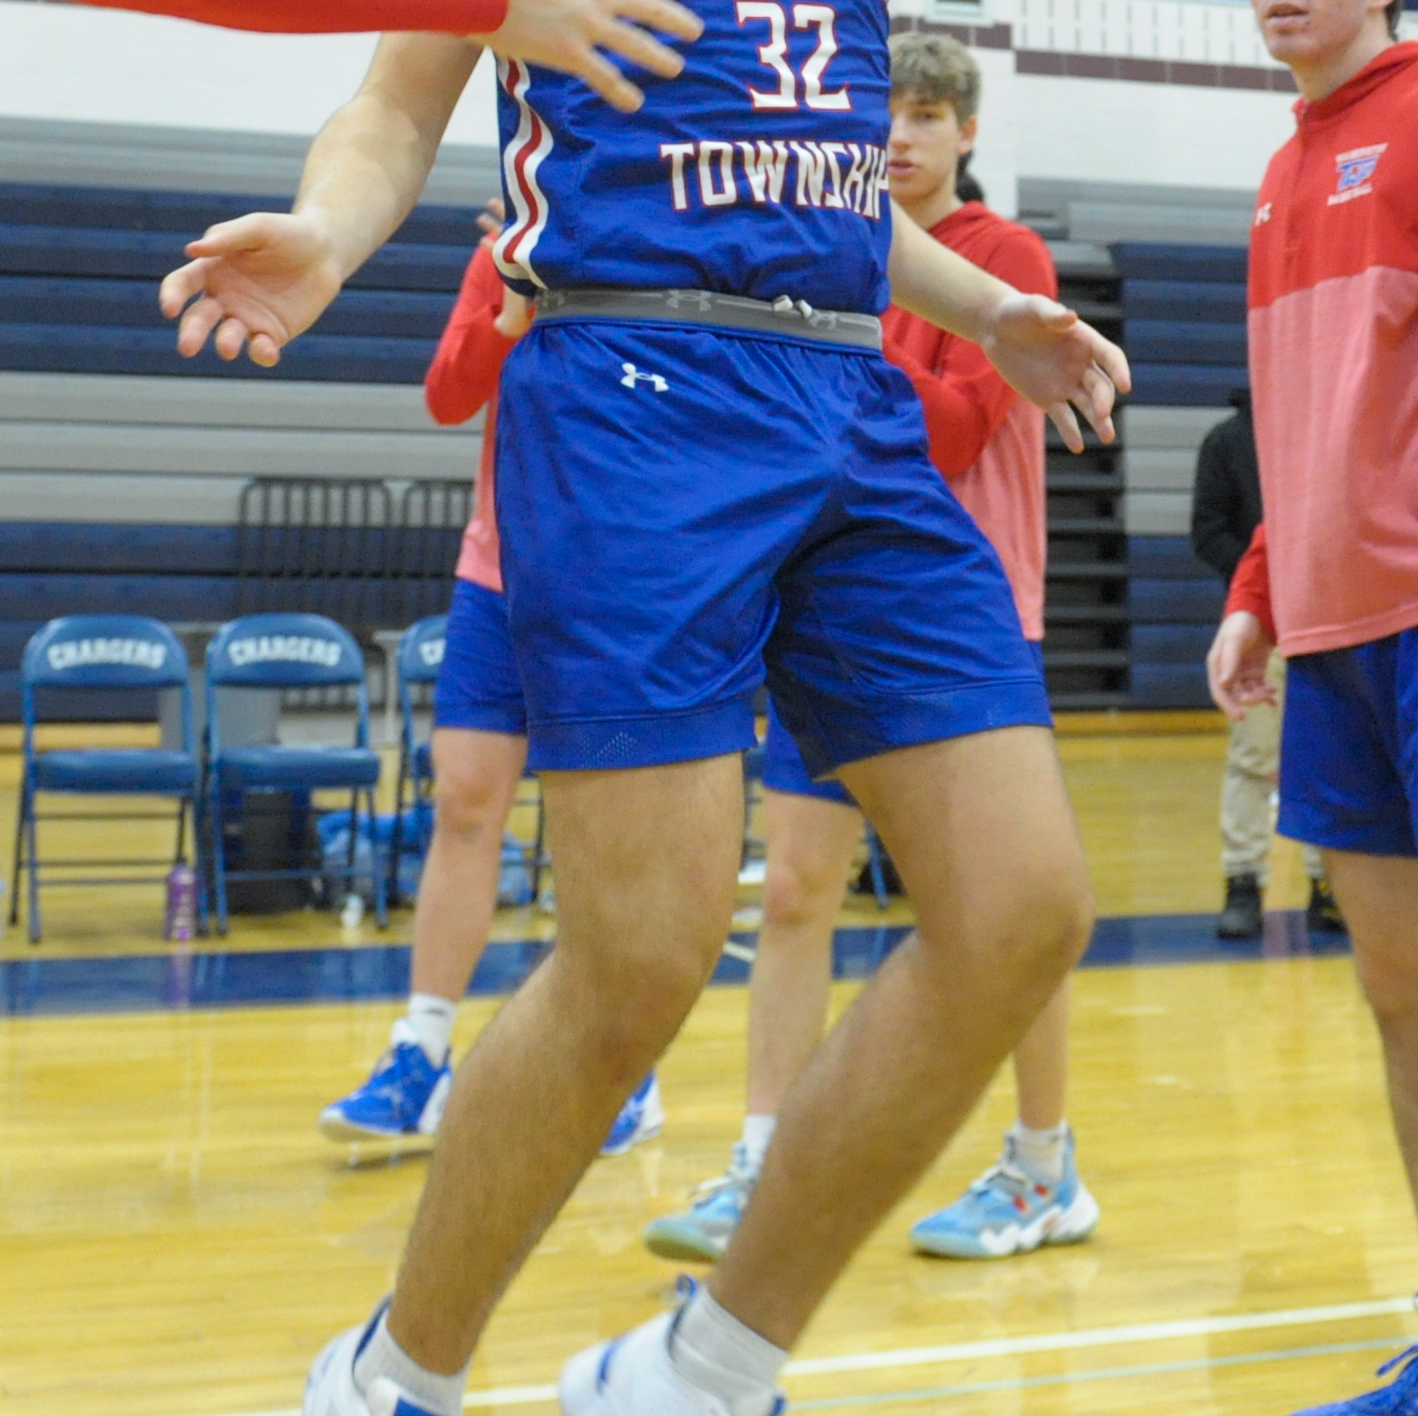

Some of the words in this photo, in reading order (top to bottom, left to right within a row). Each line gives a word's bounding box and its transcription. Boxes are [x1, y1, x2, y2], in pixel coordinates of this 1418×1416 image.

[735, 0, 852, 110] 32
[661, 140, 889, 220] TOWNSHIP
[46, 637, 167, 670] CHARGERS
[228, 635, 342, 668] CHARGERS
